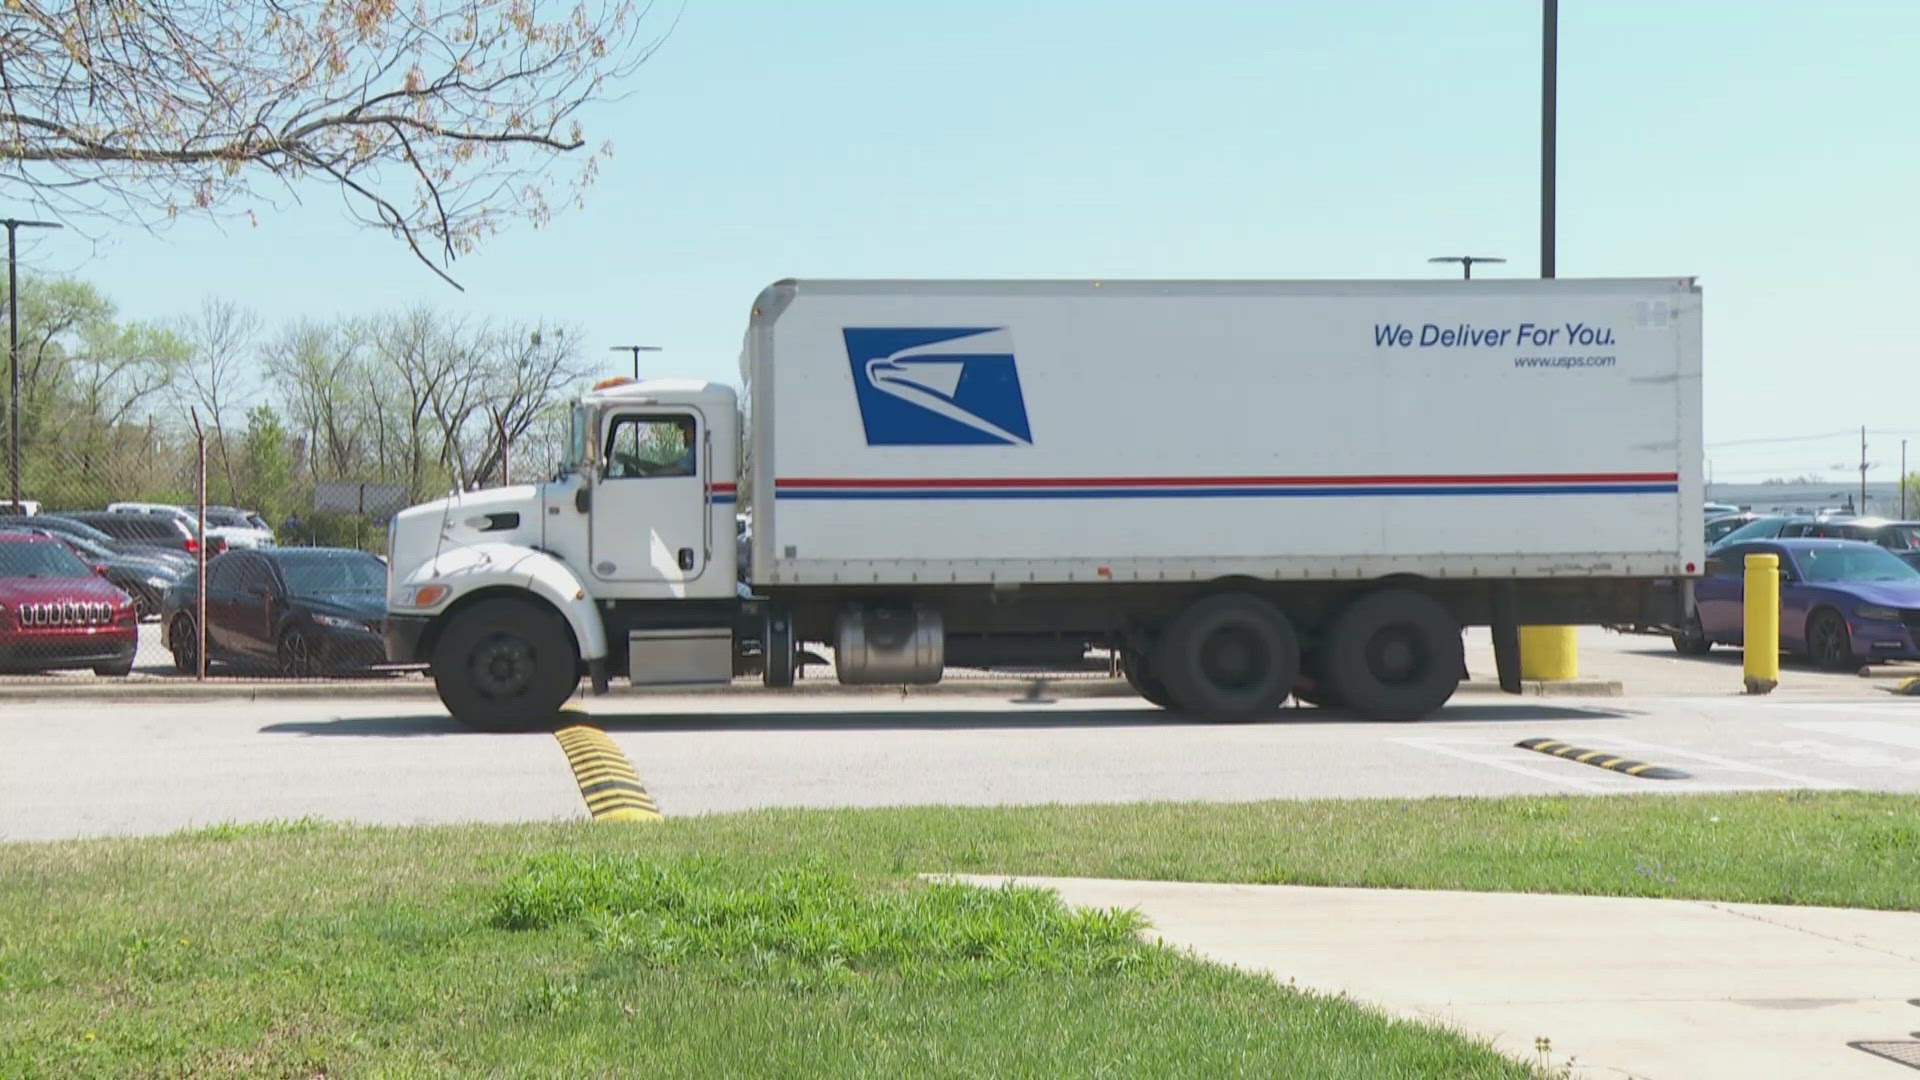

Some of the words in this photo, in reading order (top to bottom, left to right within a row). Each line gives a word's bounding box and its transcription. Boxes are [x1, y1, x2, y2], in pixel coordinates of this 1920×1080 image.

[1374, 323, 1414, 348] We
[1419, 322, 1512, 348] Deliver
[1516, 322, 1560, 347] For
[1565, 322, 1616, 347] You.
[1514, 355, 1617, 369] www.usps.com
